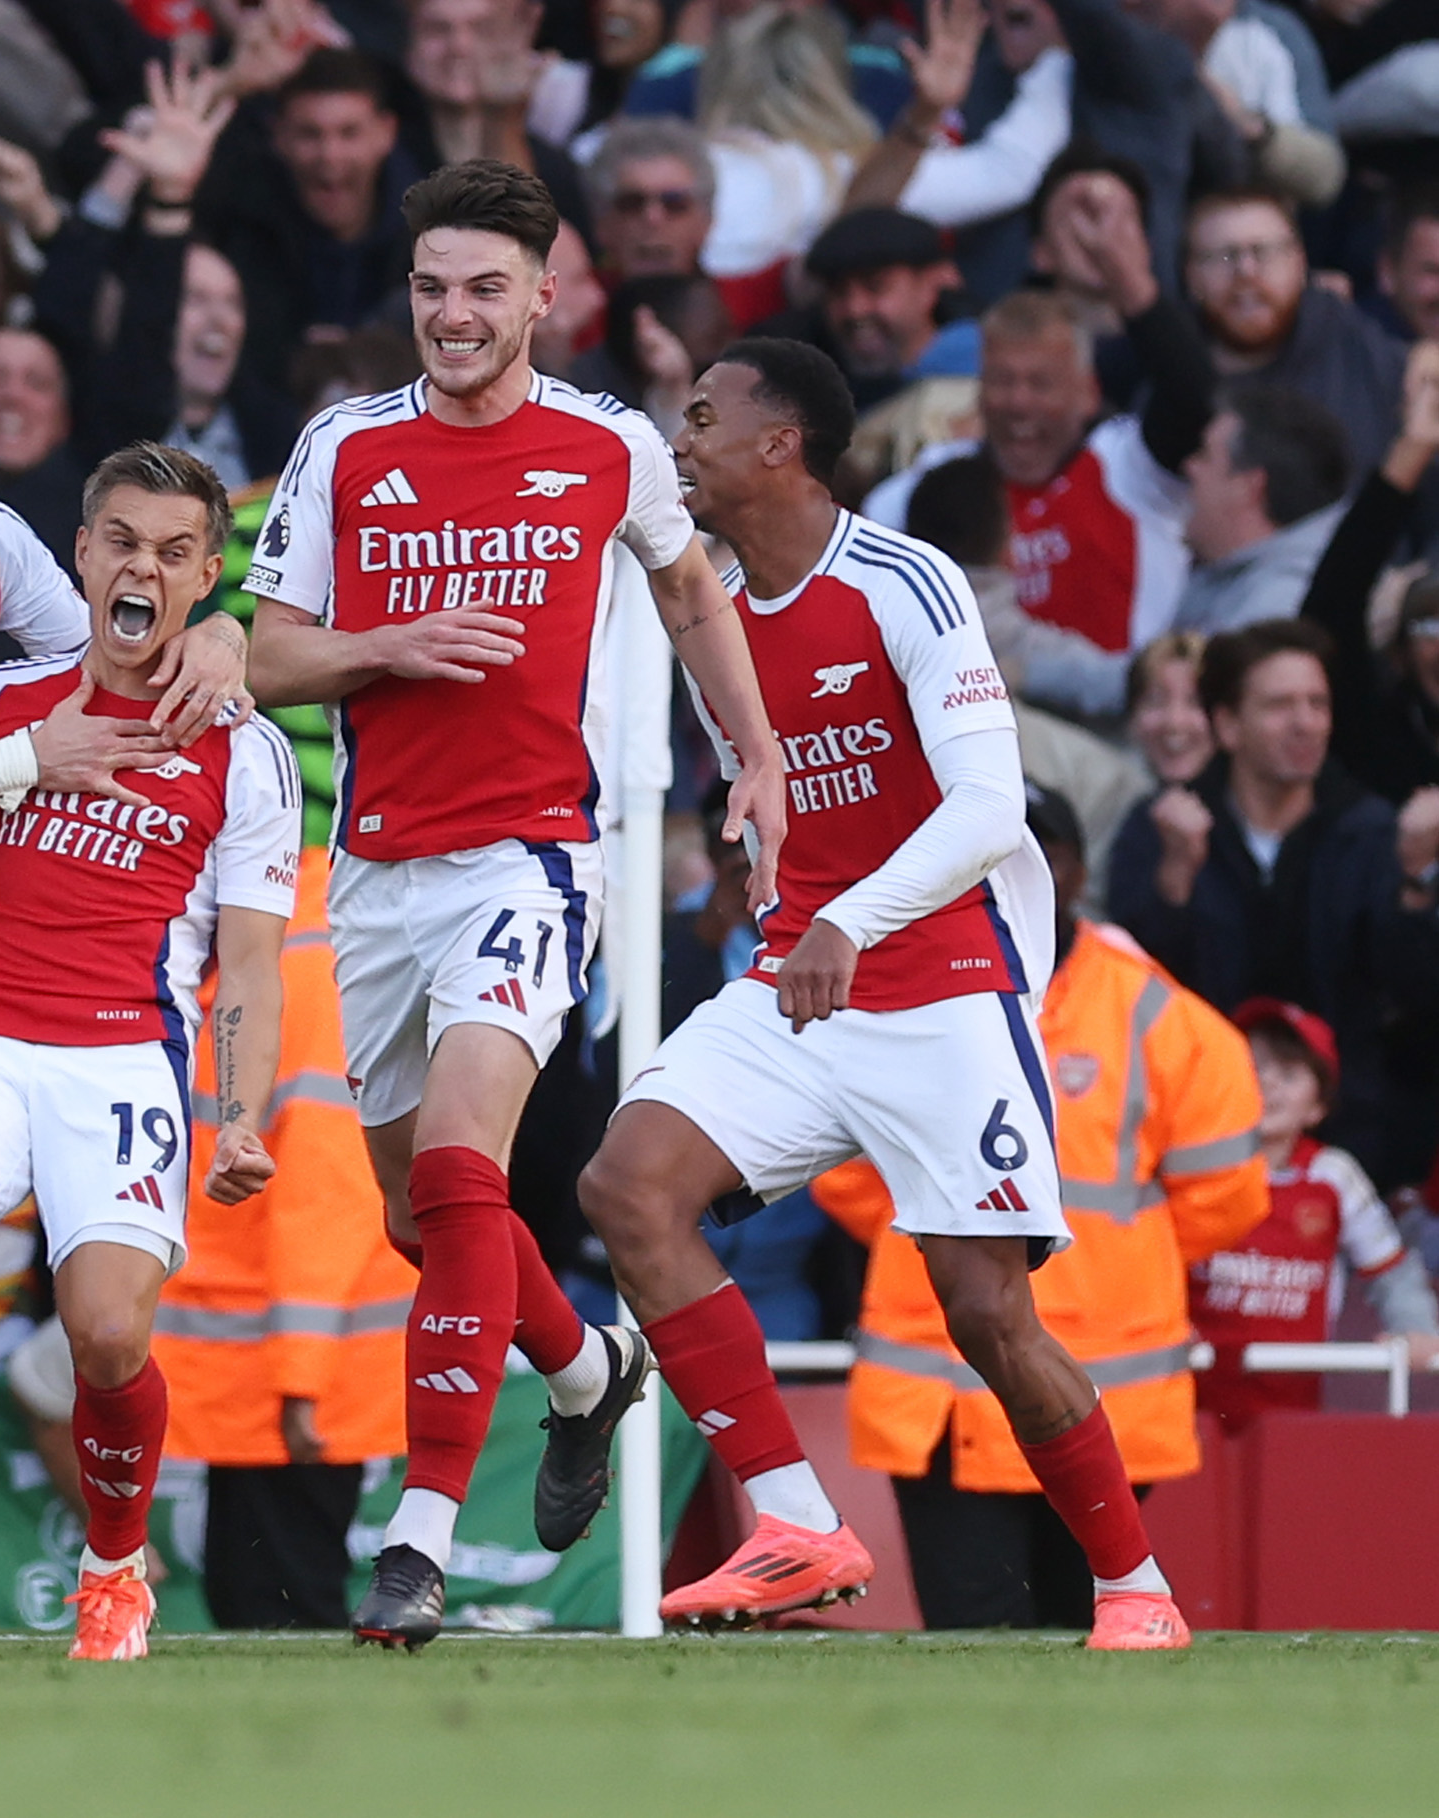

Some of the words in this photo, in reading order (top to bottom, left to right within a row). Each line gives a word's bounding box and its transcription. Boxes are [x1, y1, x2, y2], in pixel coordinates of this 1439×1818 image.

[359, 520, 582, 572] Emirates
[387, 574, 435, 614] FLY
[442, 567, 547, 610] BETTER
[943, 686, 1009, 711] RWAND
[955, 668, 996, 686] VISIT
[790, 762, 879, 814] BETTER
[37, 817, 145, 871] BETTER
[477, 908, 554, 990] 41
[111, 1102, 178, 1173] 19
[980, 1098, 1028, 1171] 6
[421, 1314, 481, 1336] AFC
[83, 1437, 143, 1463] AFC
